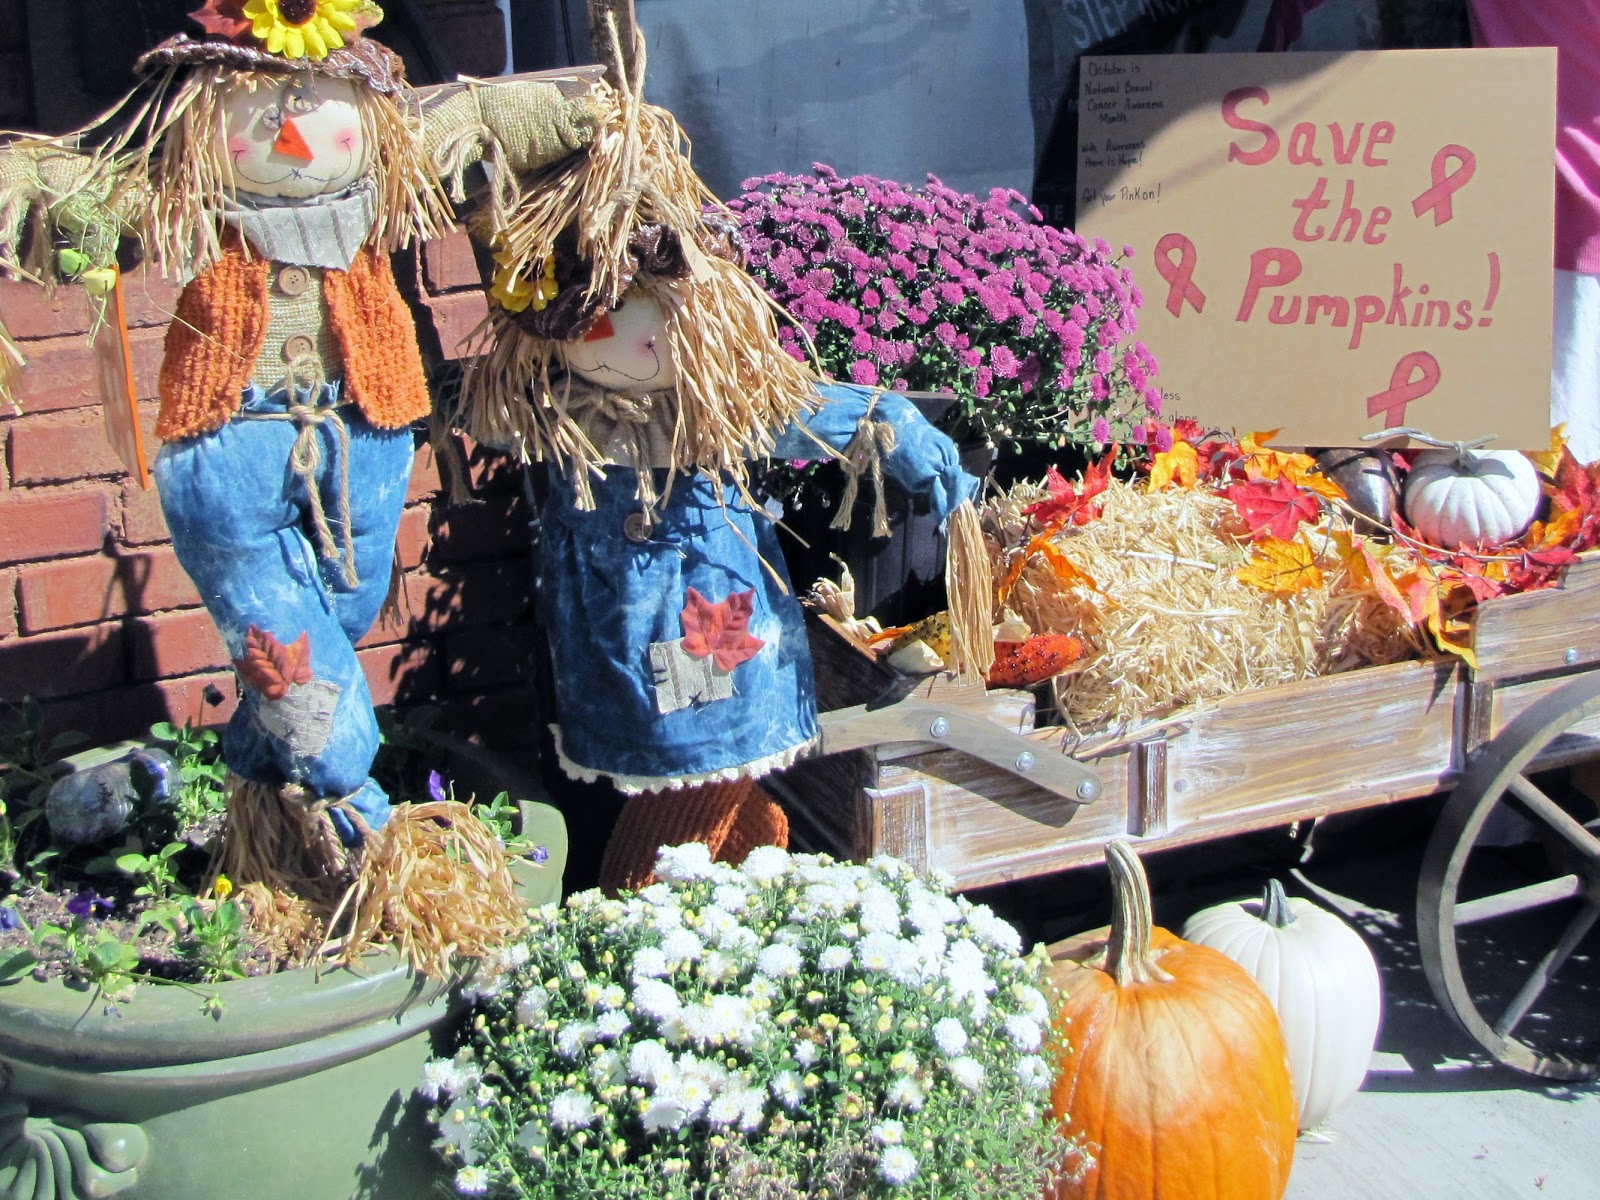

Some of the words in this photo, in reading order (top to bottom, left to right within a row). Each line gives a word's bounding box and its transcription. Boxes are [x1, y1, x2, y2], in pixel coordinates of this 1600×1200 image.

[1088, 61, 1126, 77] October
[1130, 62, 1141, 73] is
[1084, 80, 1120, 97] National
[1124, 79, 1153, 94] Breast
[1087, 98, 1118, 112] Cancer
[1099, 111, 1128, 124] Month
[1220, 86, 1396, 167] Save
[1118, 150, 1143, 169] Hope!
[1081, 186, 1097, 204] Get
[1291, 176, 1393, 246] the
[1235, 246, 1501, 350] Pumpkins!
